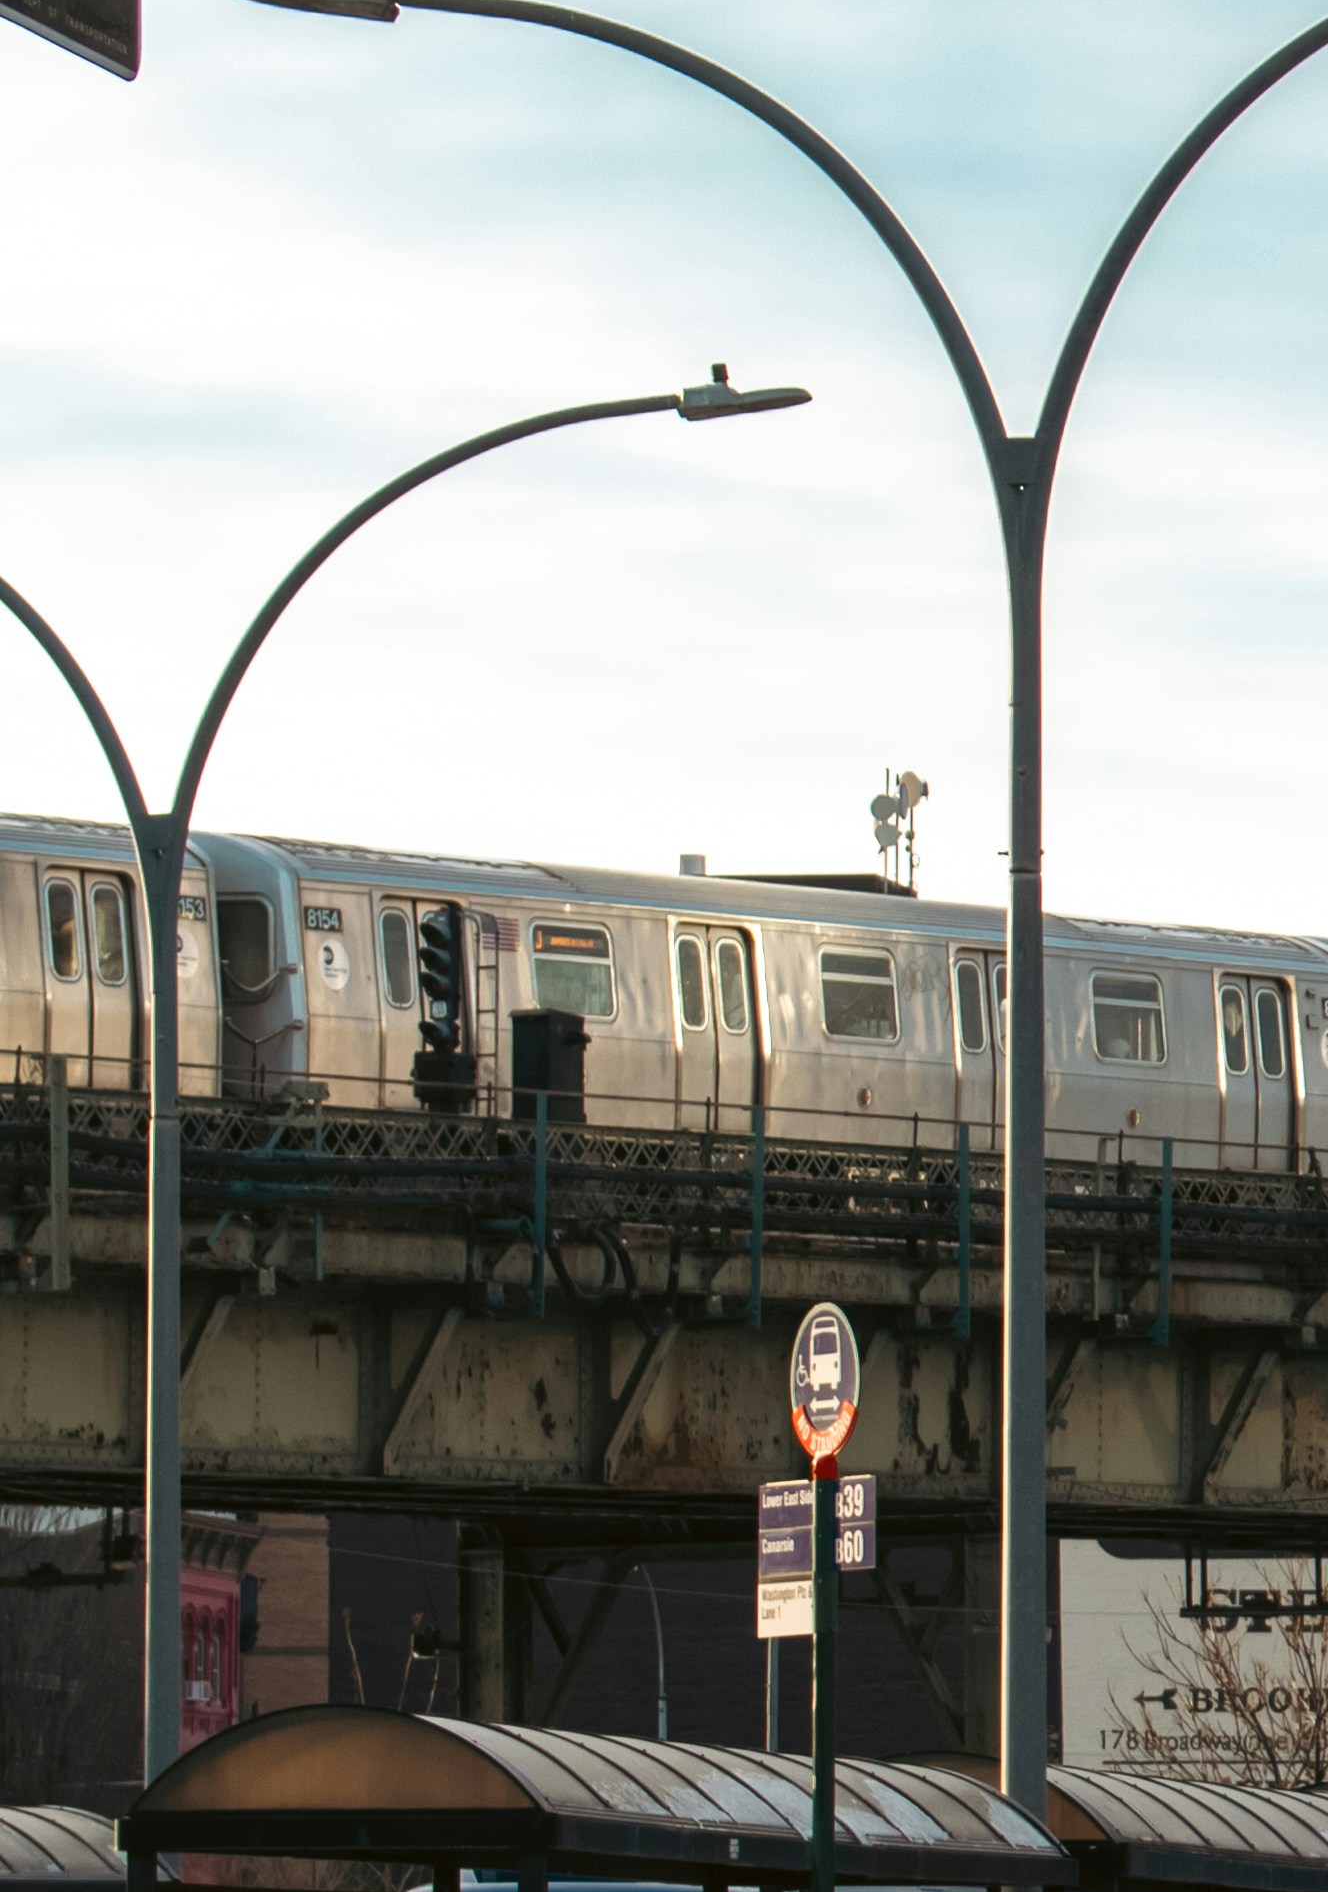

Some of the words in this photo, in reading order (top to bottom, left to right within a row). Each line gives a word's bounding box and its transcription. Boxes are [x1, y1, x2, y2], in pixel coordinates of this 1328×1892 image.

[65, 12, 128, 55] TRANSPORTATION
[178, 897, 205, 919] 153
[307, 908, 340, 929] 8154
[797, 1414, 811, 1441] NO
[810, 1410, 851, 1451] STANDING
[762, 1493, 783, 1509] Lower
[783, 1491, 799, 1506] East
[835, 1483, 865, 1519] B39
[762, 1537, 795, 1554] Canarsie
[835, 1529, 864, 1564] B60
[1100, 1729, 1139, 1751] 178
